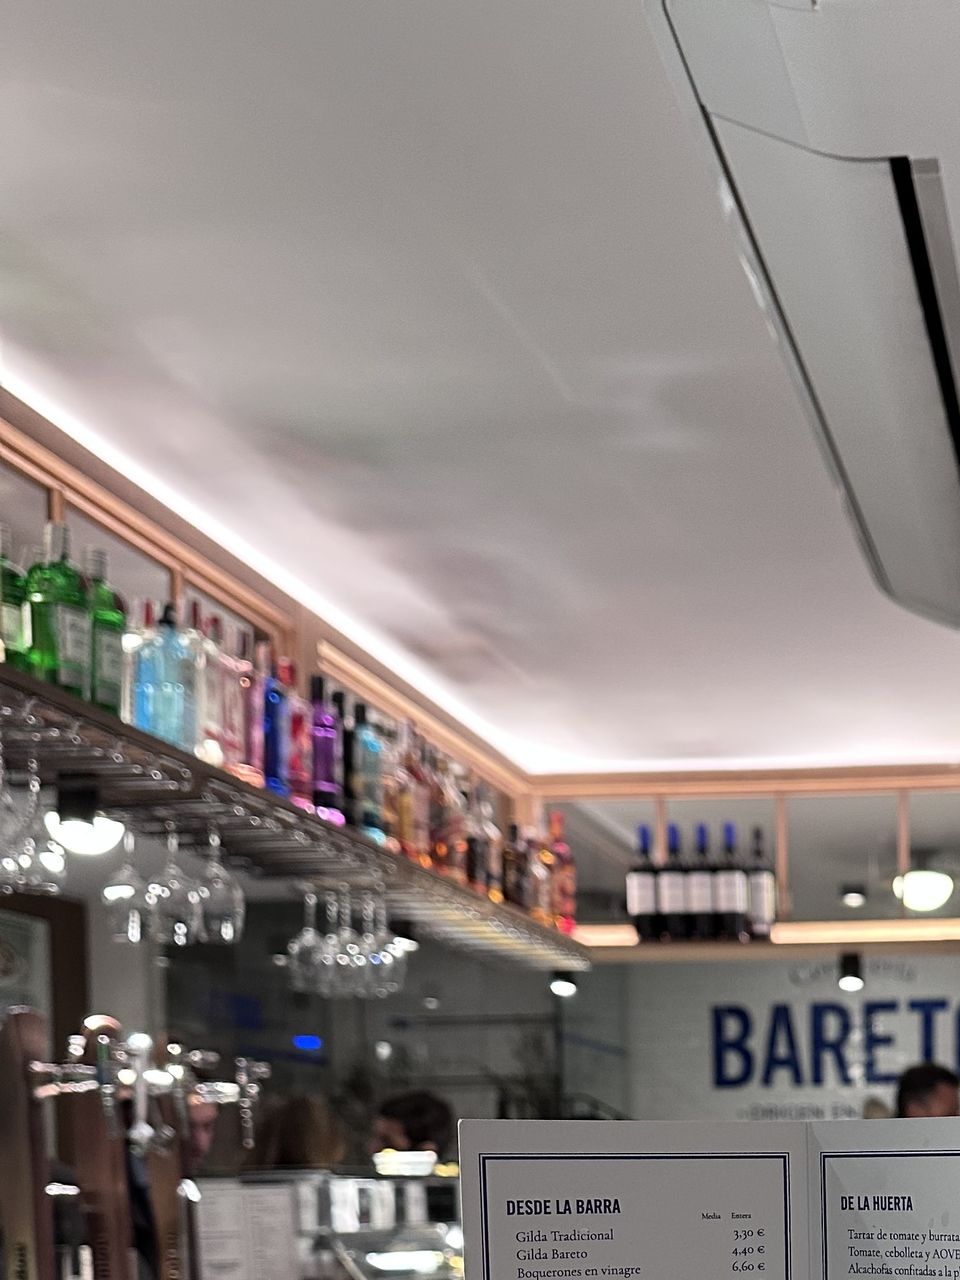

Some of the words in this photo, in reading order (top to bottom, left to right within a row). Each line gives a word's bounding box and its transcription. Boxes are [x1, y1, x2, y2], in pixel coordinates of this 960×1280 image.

[506, 1199, 552, 1216] DESDE
[555, 1199, 572, 1215] LA
[575, 1198, 621, 1215] BARRA
[840, 1195, 855, 1211] DE
[857, 1195, 871, 1211] LA
[872, 1195, 914, 1212] HUERTA
[701, 1212, 721, 1220] Media
[515, 1229, 548, 1243] Gilda
[550, 1228, 614, 1242] Tradicional
[733, 1229, 754, 1241] 3,30
[756, 1228, 766, 1237] €
[847, 1229, 876, 1240] Tartar
[876, 1228, 888, 1240] de
[889, 1232, 920, 1241] tomate
[920, 1233, 927, 1245] y
[928, 1229, 960, 1242] burrata
[516, 1247, 549, 1261] Gilda
[551, 1248, 588, 1260] Bareto
[731, 1246, 755, 1257] 4,40
[757, 1245, 765, 1254] €
[847, 1245, 883, 1260] Tomate,
[884, 1245, 924, 1259] cebolleta
[924, 1251, 931, 1263] y
[932, 1248, 960, 1260] AOVE
[584, 1268, 598, 1277] en
[600, 1265, 641, 1279] vinagre
